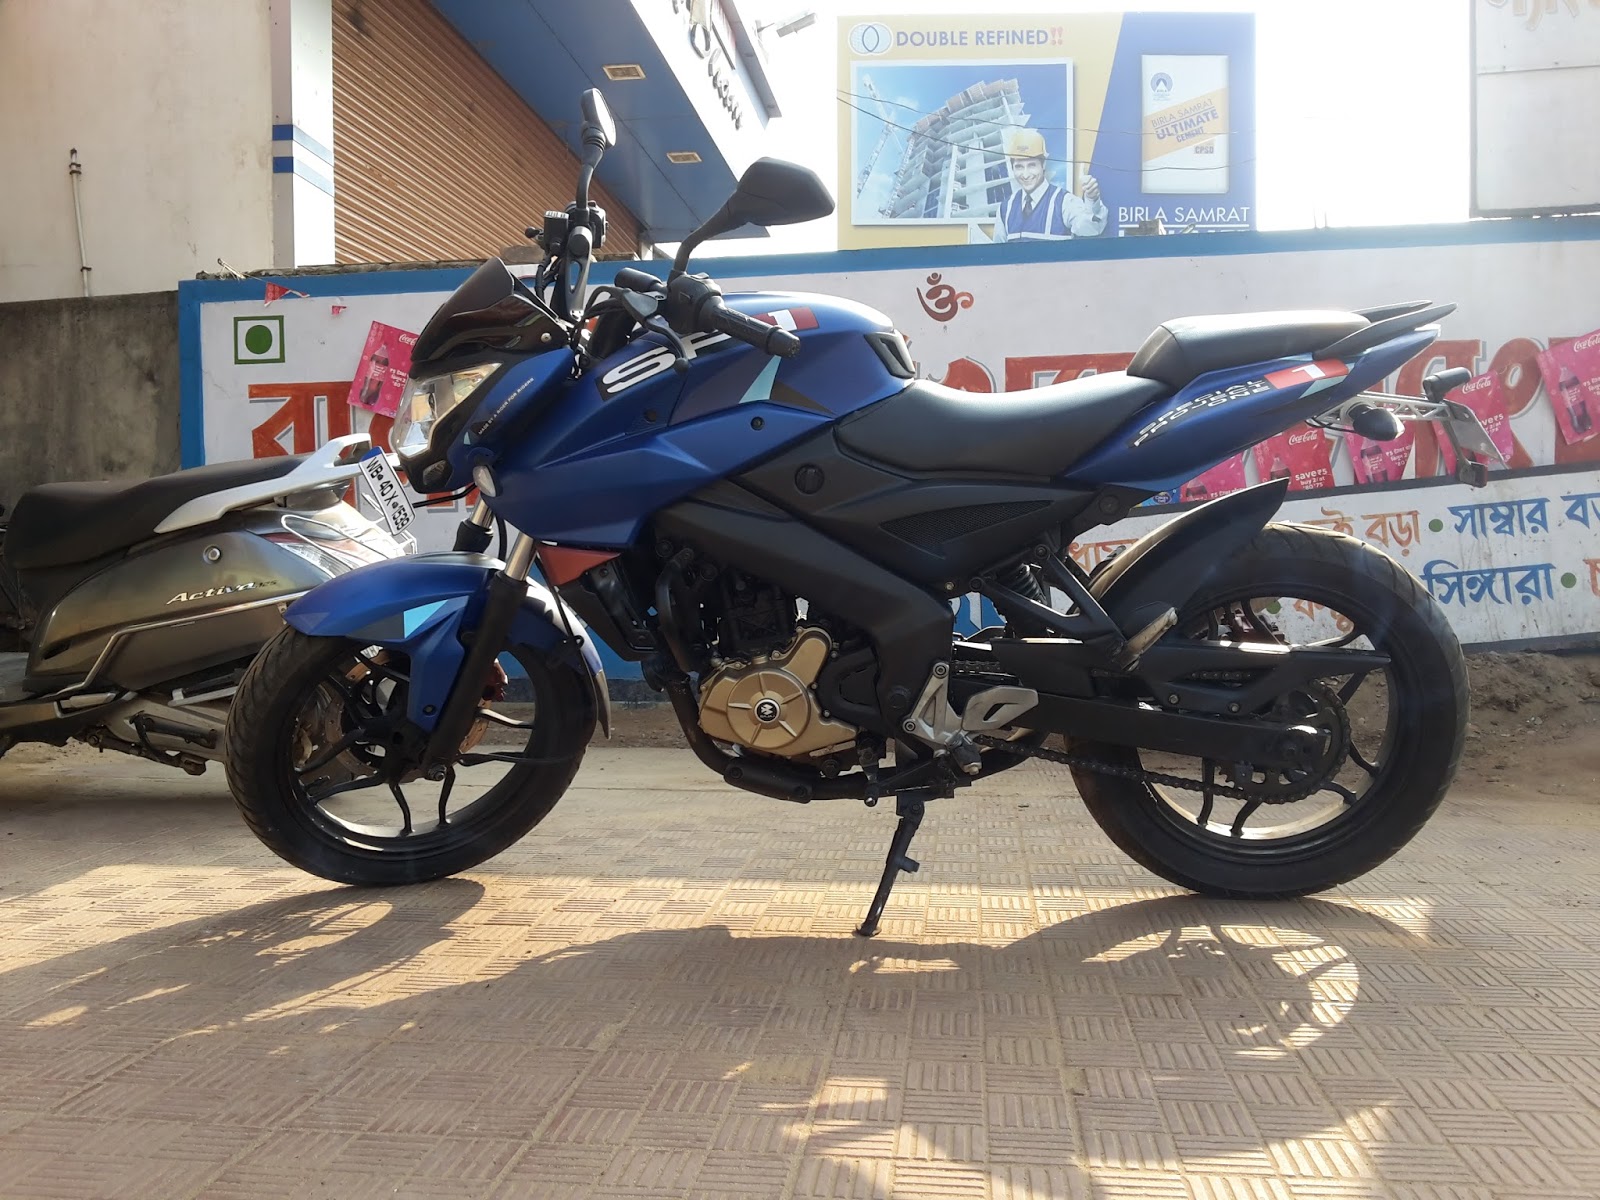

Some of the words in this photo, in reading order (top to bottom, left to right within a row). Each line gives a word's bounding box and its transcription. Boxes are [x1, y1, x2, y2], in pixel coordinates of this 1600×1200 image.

[896, 30, 968, 47] DOUBLE
[1151, 112, 1176, 128] BIRLA
[1177, 98, 1214, 119] SAMRAT
[1155, 108, 1219, 140] ULTIMATE
[1118, 206, 1168, 223] BIRLA
[1174, 206, 1251, 223] SAMRAT
[507, 392, 518, 402] FOR
[366, 456, 384, 479] WB
[379, 480, 394, 497] 40
[384, 490, 399, 507] X
[166, 581, 257, 605] Activa
